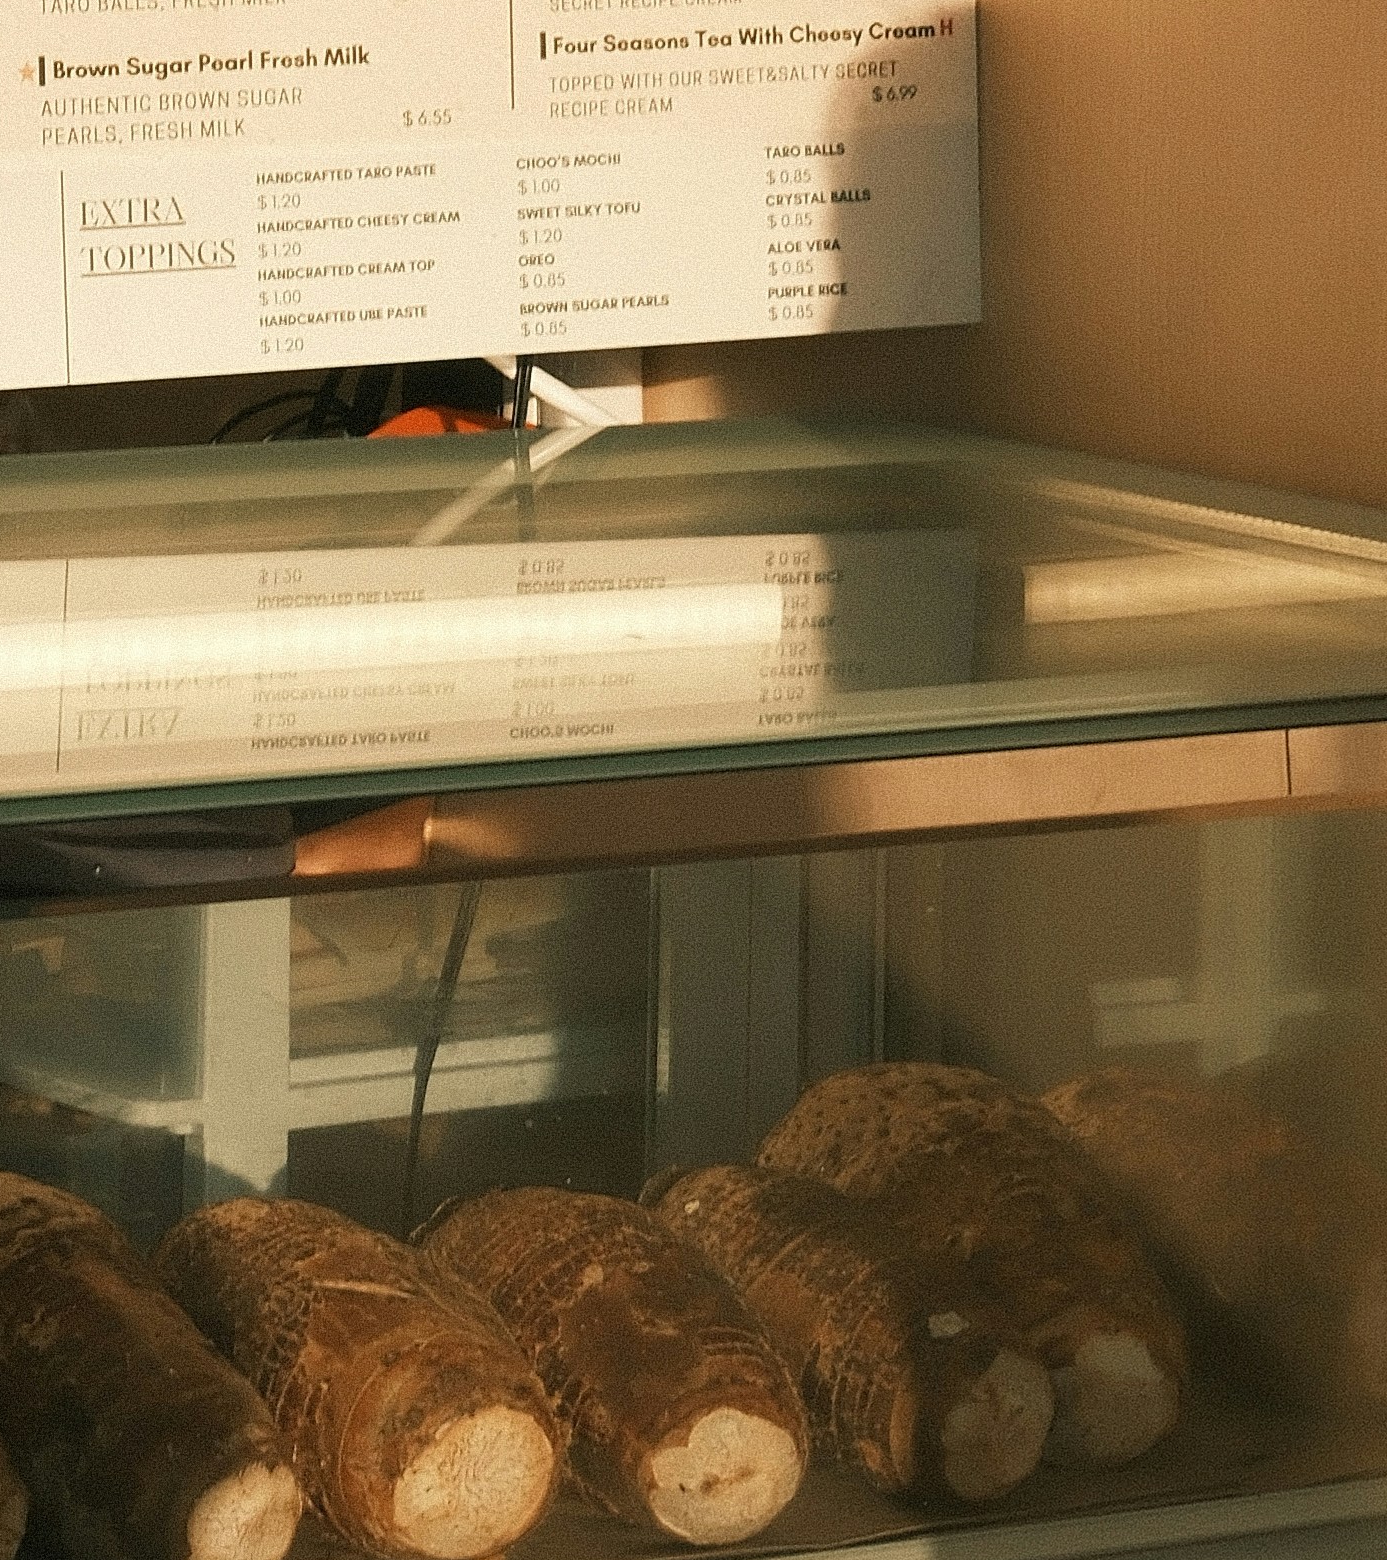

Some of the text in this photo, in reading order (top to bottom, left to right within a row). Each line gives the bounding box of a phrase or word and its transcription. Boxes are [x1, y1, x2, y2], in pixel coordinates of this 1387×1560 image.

[358, 166, 392, 179] TARO
[395, 164, 435, 177] PASTE
[81, 197, 185, 231] EXTRA
[82, 241, 236, 277] TOPPINGS
